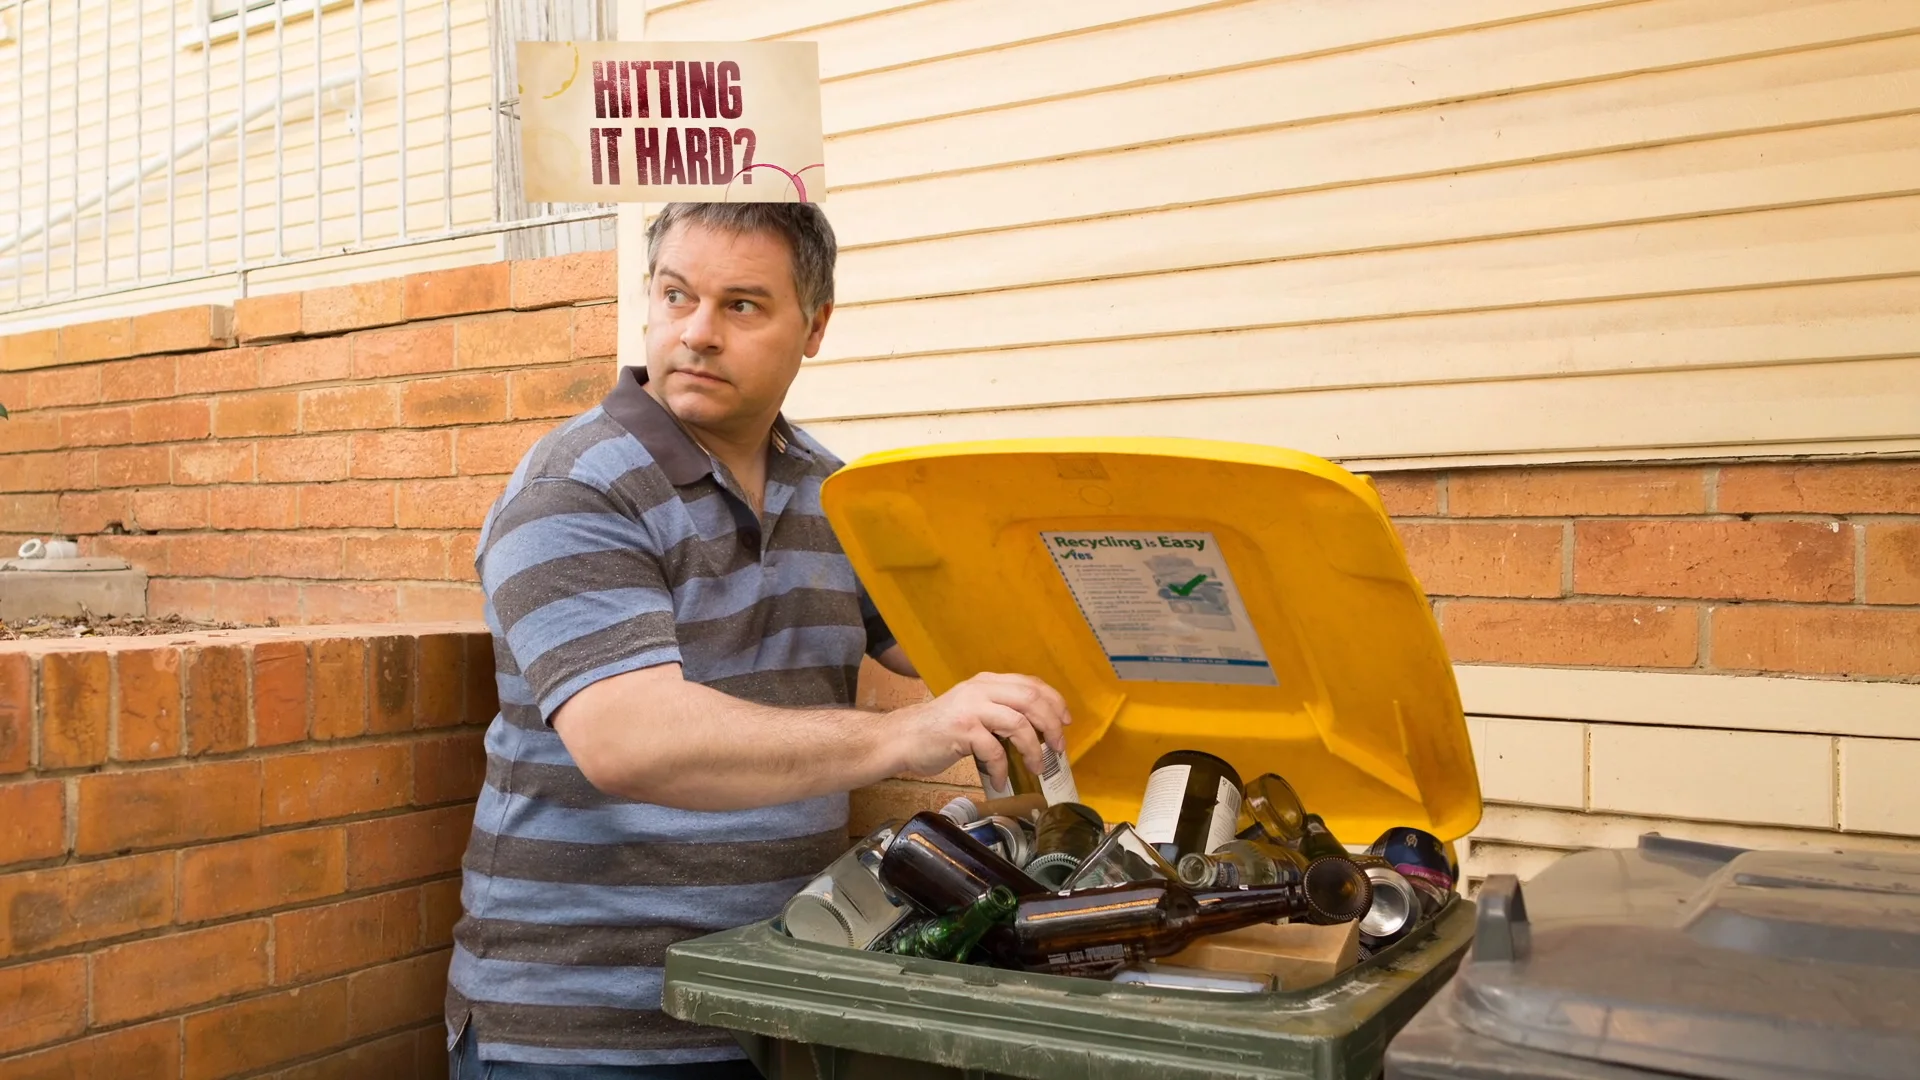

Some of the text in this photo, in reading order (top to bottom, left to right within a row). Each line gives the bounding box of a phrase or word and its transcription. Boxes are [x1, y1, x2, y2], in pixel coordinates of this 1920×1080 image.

[1054, 535, 1206, 551] Recycling is Easy
[1070, 551, 1093, 560] Yes
